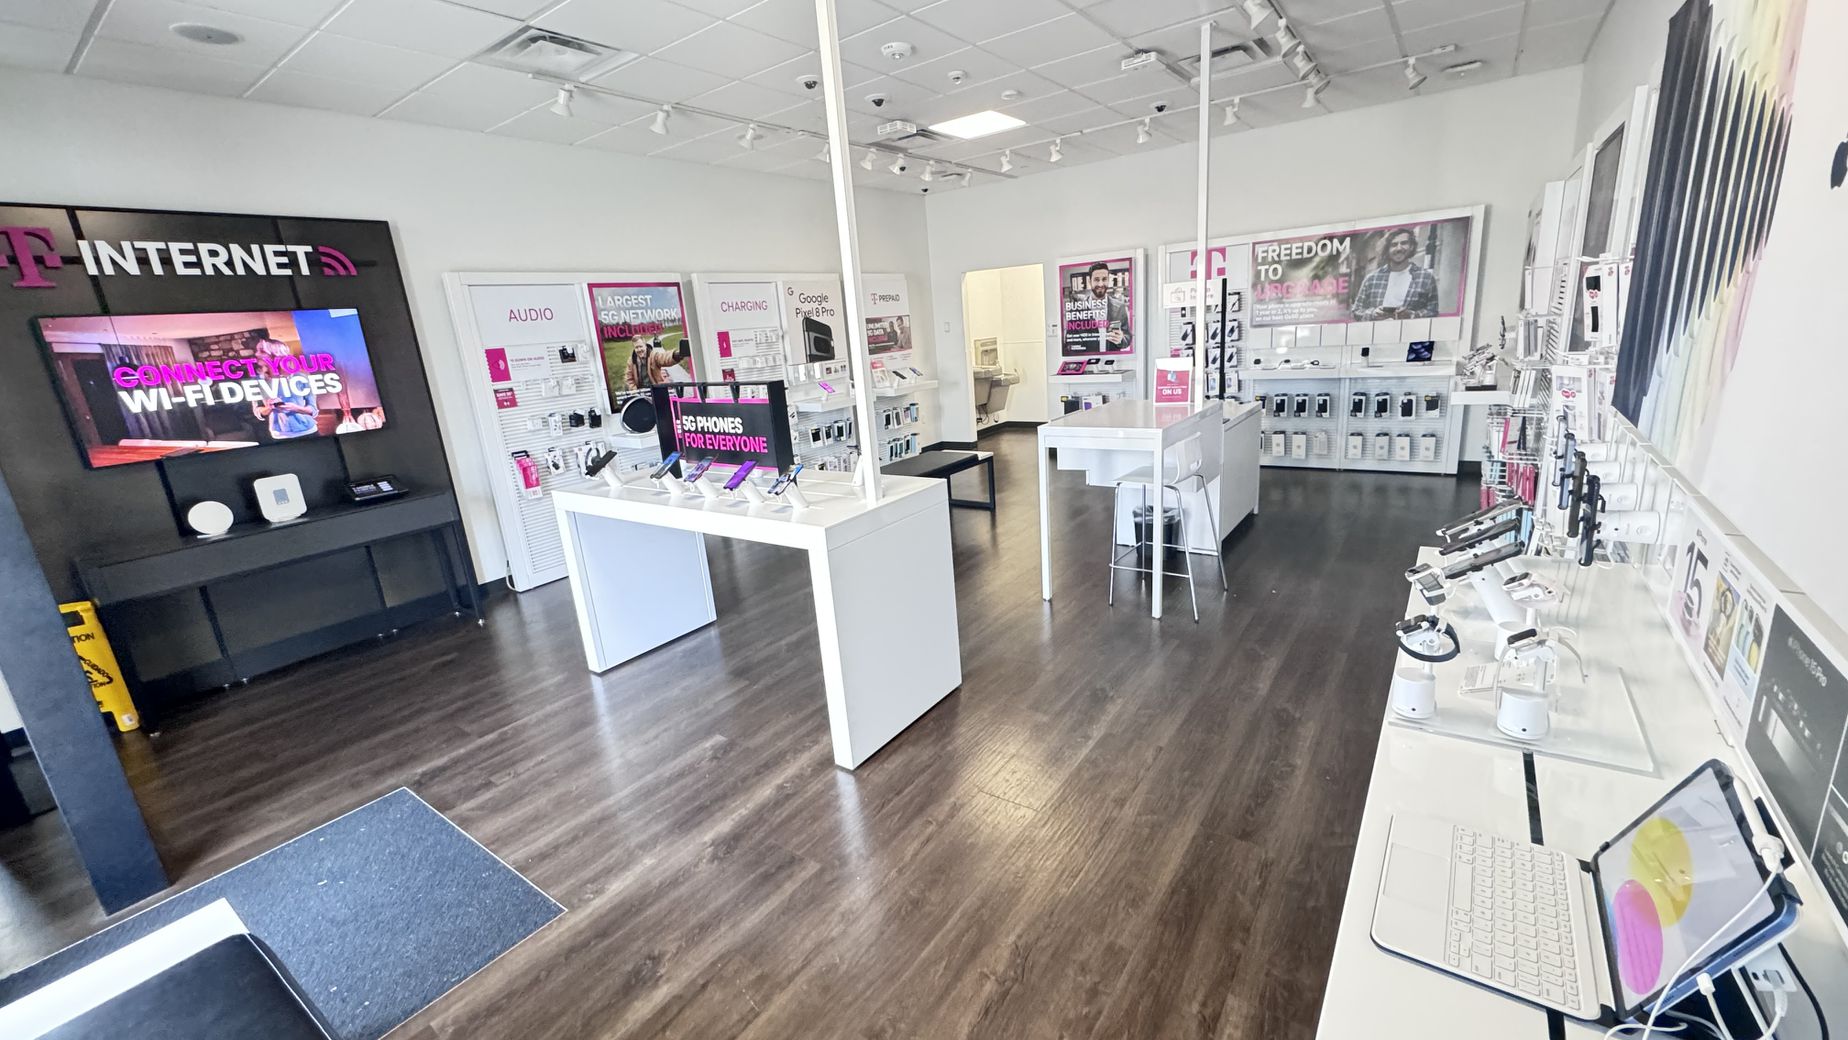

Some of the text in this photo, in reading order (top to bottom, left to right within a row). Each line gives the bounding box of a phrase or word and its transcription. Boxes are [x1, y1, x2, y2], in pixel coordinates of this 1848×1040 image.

[1257, 237, 1351, 262] FREEDOM
[77, 240, 314, 277] INTERNET
[1257, 263, 1282, 281] TO
[787, 286, 794, 296] G
[1255, 276, 1350, 300] UPGRADE
[598, 294, 652, 310] LARGEST
[720, 300, 768, 313] CHARGING
[798, 292, 829, 306] Google
[878, 294, 901, 303] PREPAID
[1065, 299, 1108, 311] BUSINESS
[508, 307, 554, 323] AUDIO
[601, 307, 678, 325] 5G NETWORK
[795, 306, 835, 319] Pixel 8 Pro
[1065, 309, 1106, 321] BENEFITS
[603, 322, 664, 339] INCLUDED
[1066, 319, 1109, 331] INCLUDED
[113, 353, 335, 388] CONNECT YOUR
[118, 373, 343, 414] WI-FI DEVICES
[1162, 388, 1172, 396] ON
[682, 415, 696, 432] 5G
[697, 416, 744, 435] PHONES
[684, 432, 768, 454] FOR EVERYONE
[1682, 541, 1709, 619] 15
